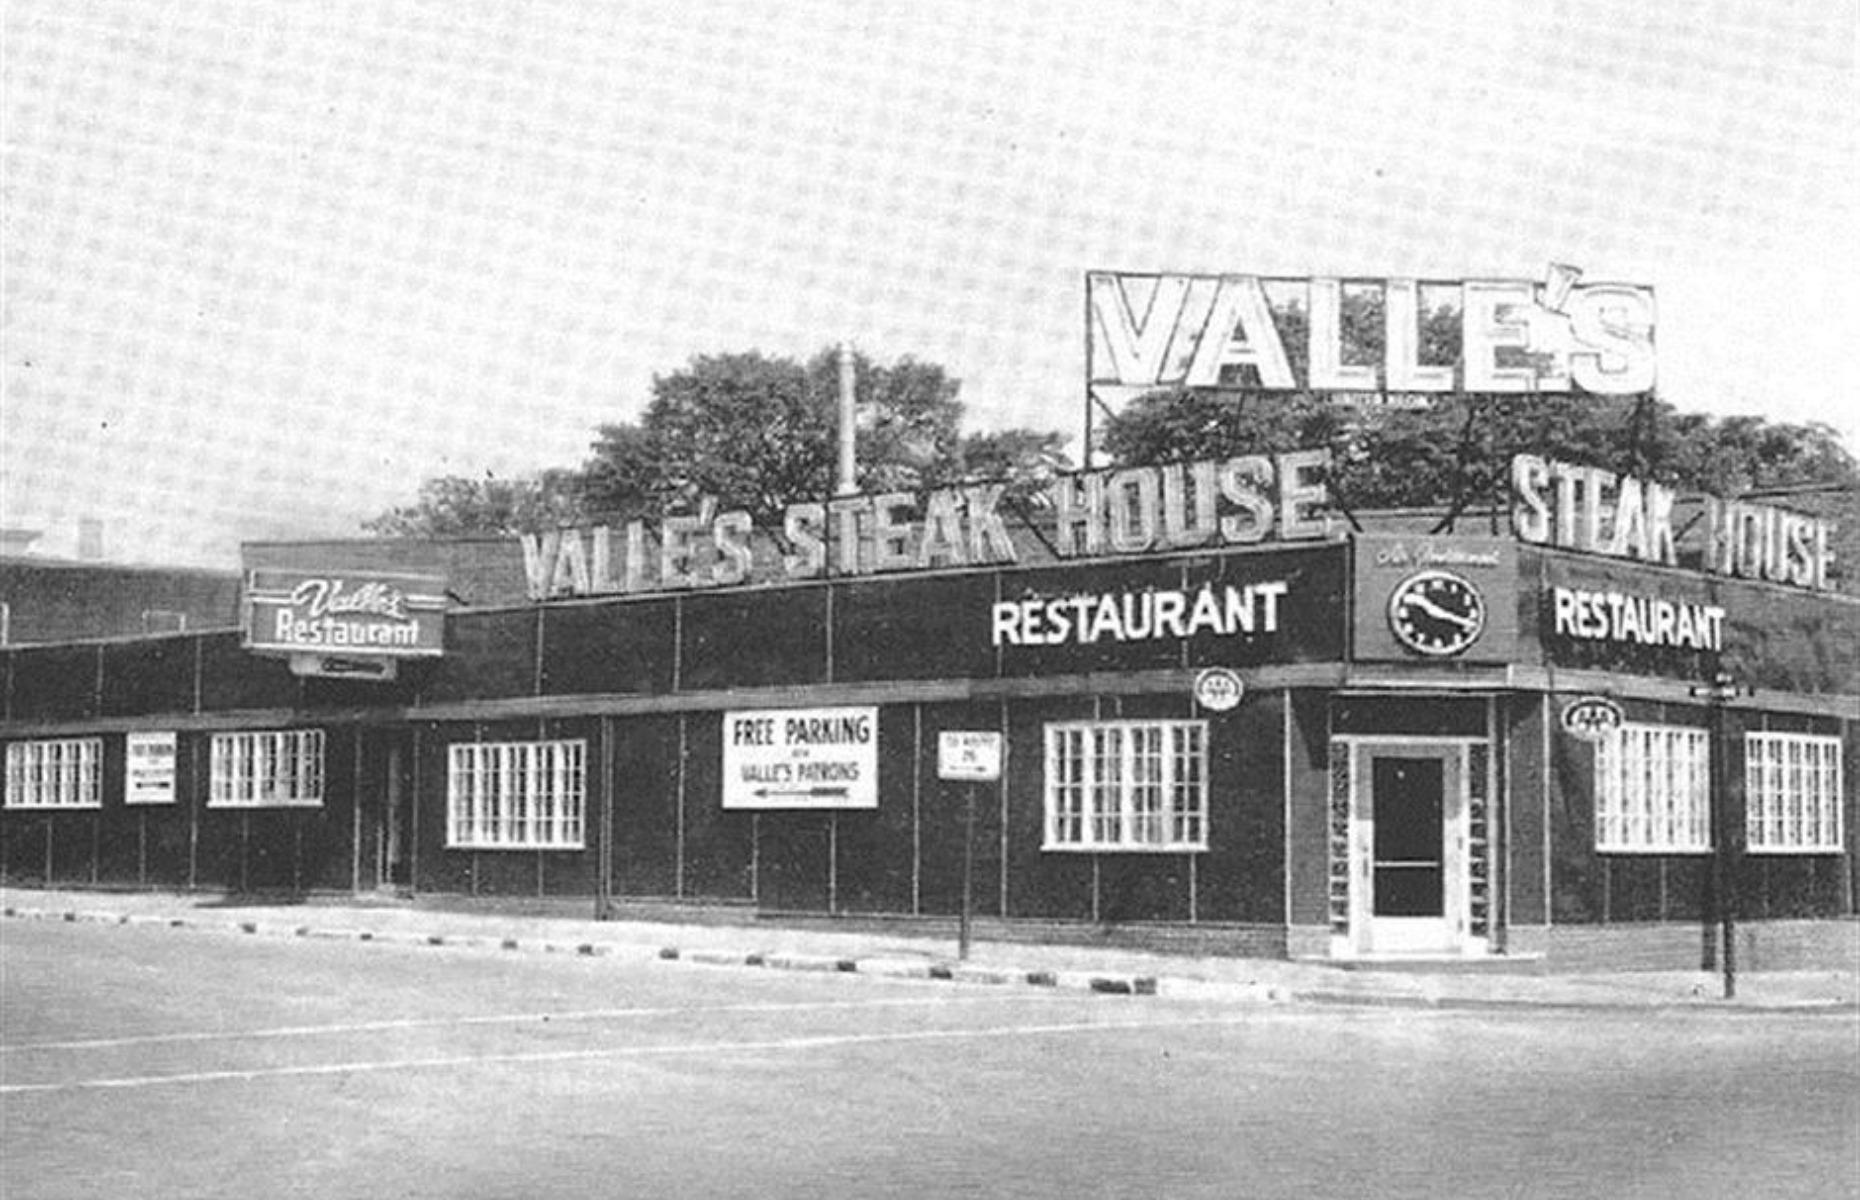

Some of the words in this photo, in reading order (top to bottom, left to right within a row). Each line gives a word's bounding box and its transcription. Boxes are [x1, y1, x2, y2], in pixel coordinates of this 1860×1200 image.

[1089, 262, 1656, 395] VALLE'S
[520, 495, 754, 600] VALLE'S
[784, 486, 1018, 578] STEAK
[1053, 448, 1333, 557] HOUSE
[1511, 453, 1679, 566] STEAK
[1702, 497, 1837, 591] HOUSE
[276, 608, 419, 645] Restaurant
[992, 582, 1288, 646] RESTAURANT
[1553, 586, 1726, 651] RESTAURANT
[733, 717, 775, 746] FREE
[784, 714, 871, 745] PARKING
